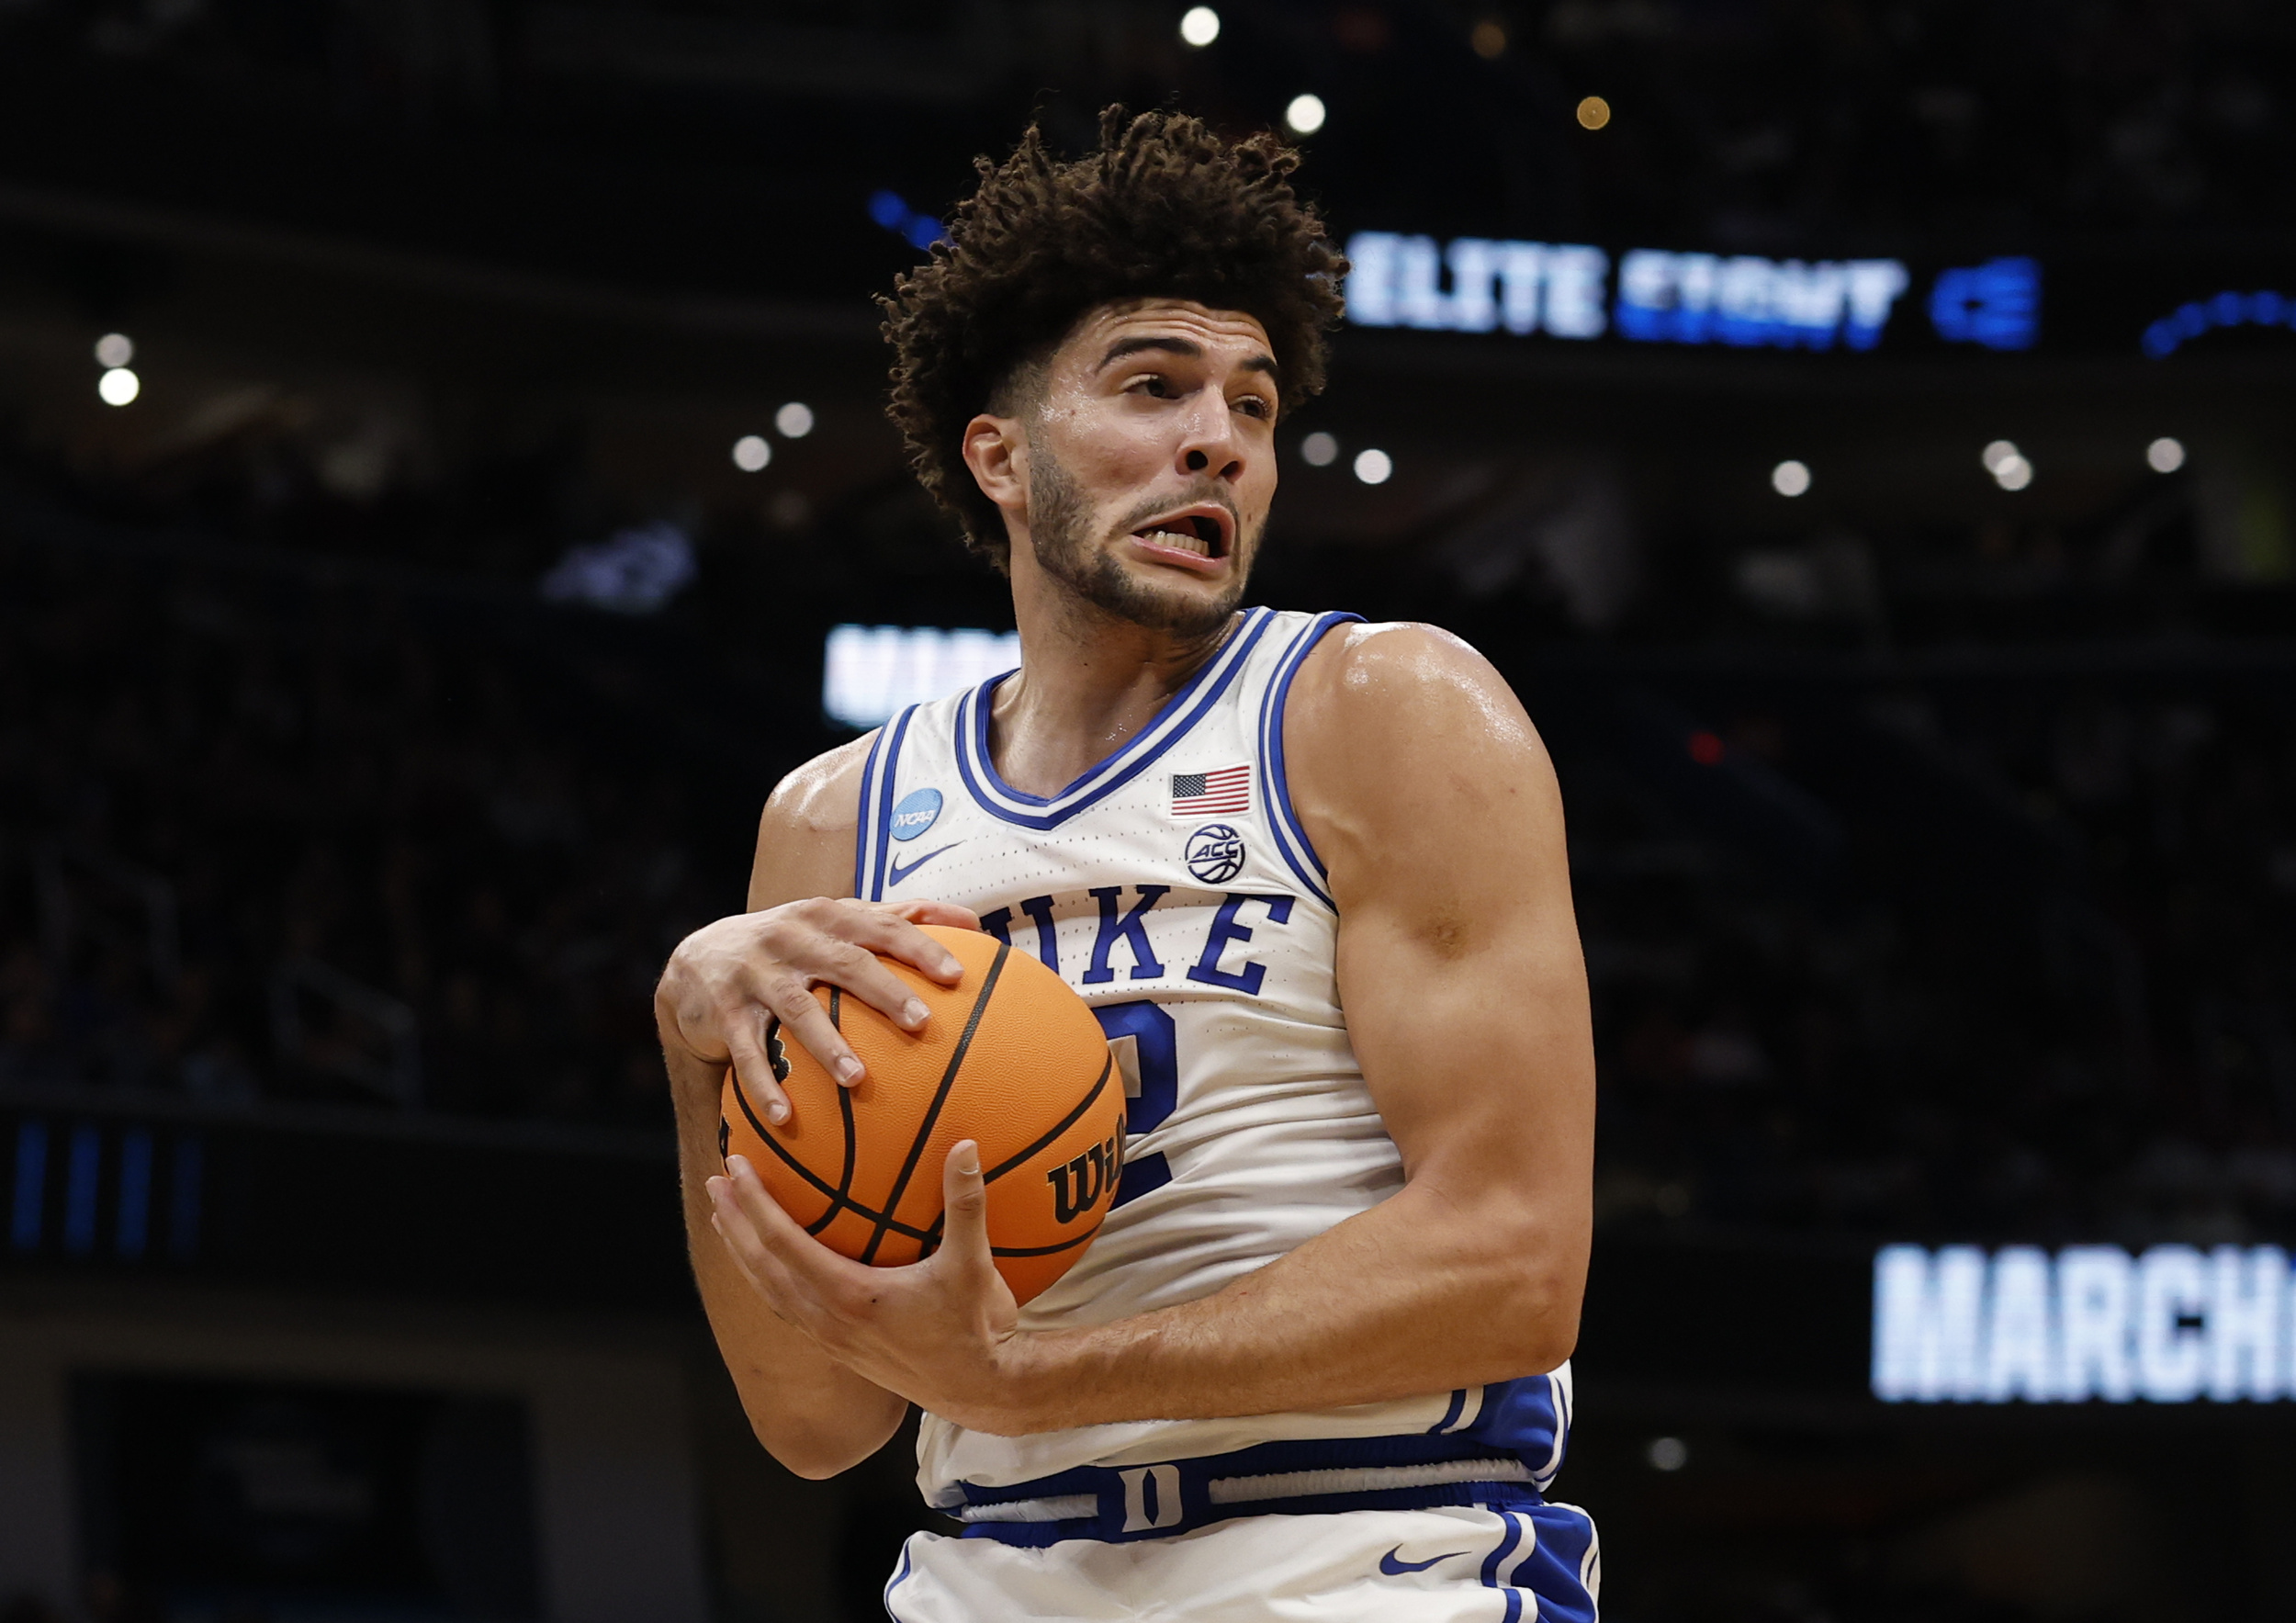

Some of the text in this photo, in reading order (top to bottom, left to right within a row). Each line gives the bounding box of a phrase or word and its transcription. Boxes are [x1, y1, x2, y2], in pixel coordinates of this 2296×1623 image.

[1346, 231, 1610, 338] ELITE
[894, 809, 936, 828] NCAA
[1192, 840, 1240, 859] ACC
[979, 884, 1296, 996] UKE
[1872, 1244, 2289, 1403] MARCH
